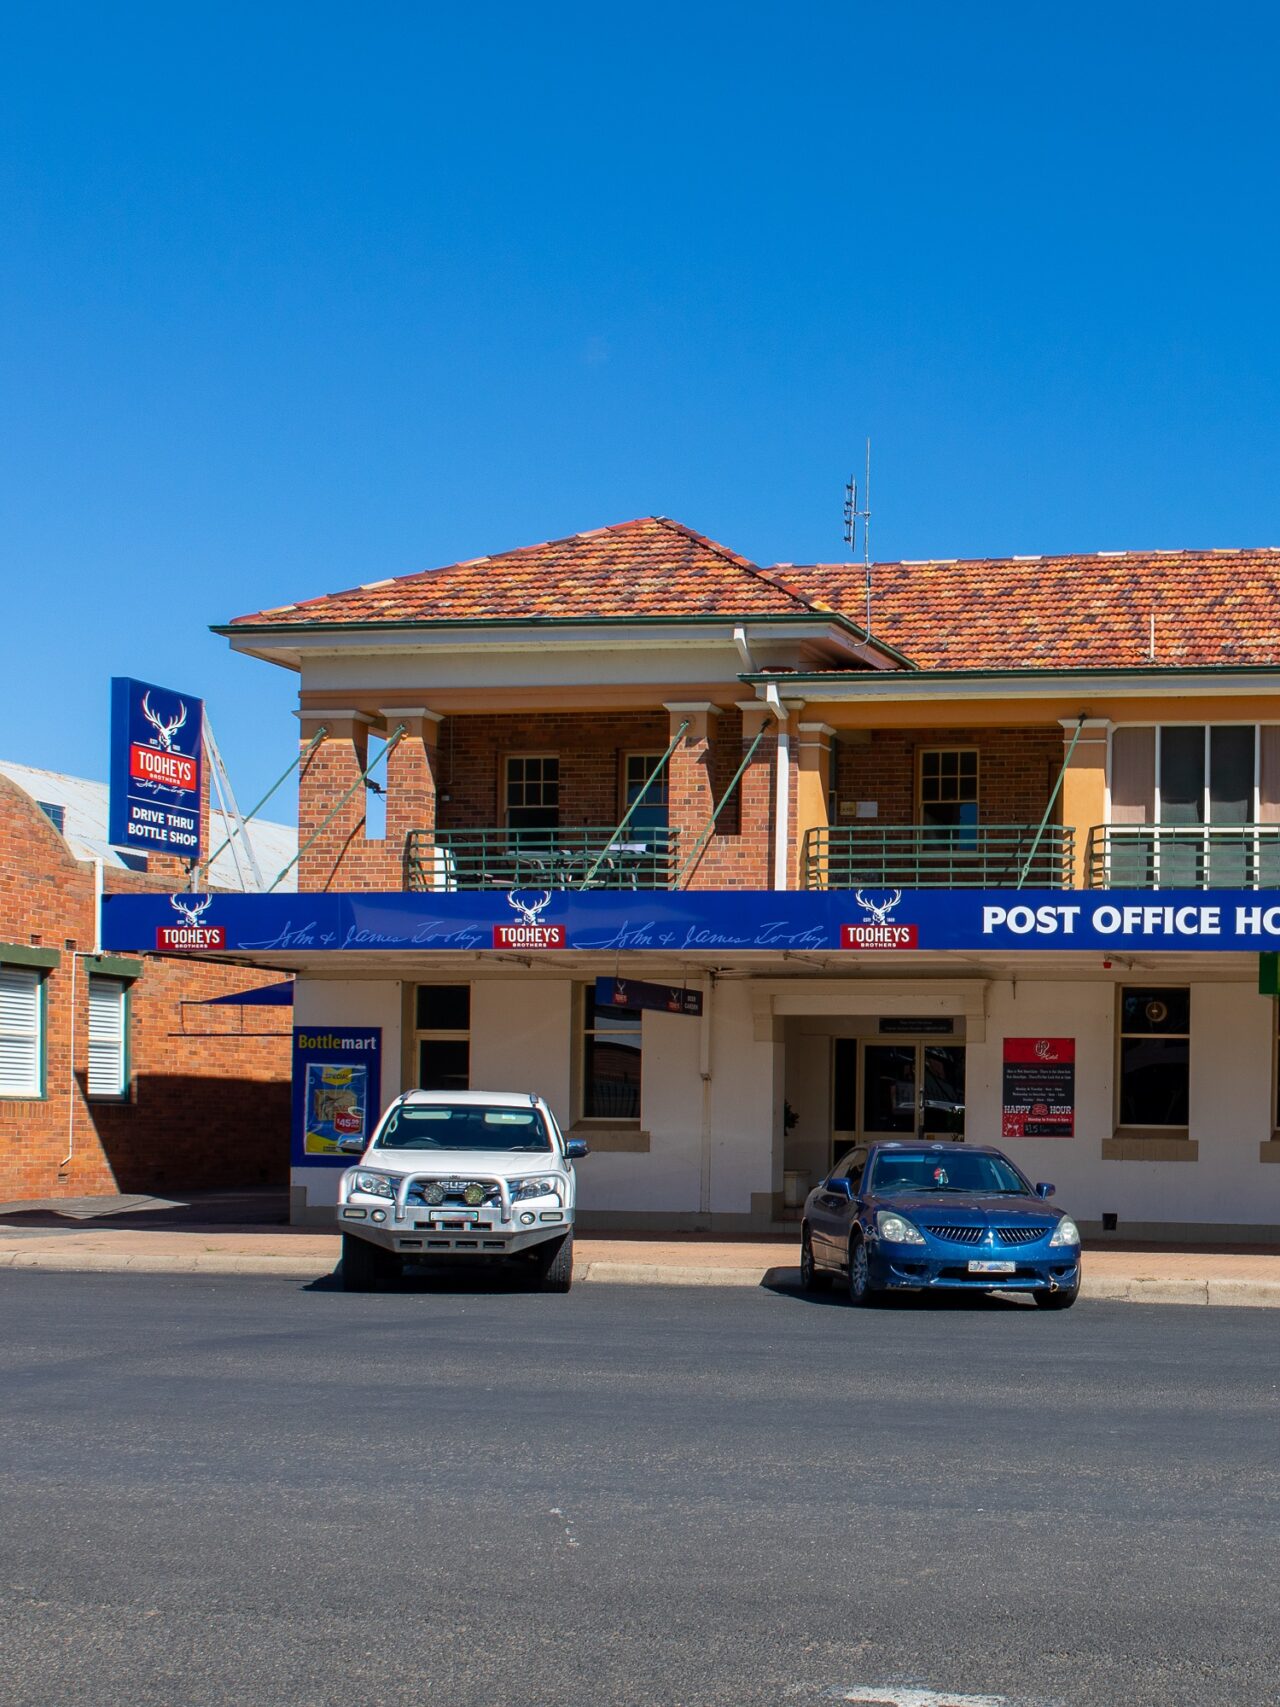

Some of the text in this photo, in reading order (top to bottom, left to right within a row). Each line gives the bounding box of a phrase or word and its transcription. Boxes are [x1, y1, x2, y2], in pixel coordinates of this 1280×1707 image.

[138, 751, 191, 781] TOOHEYS
[149, 773, 181, 785] BROTHERS
[132, 806, 195, 830] DRIVE THRU
[128, 823, 198, 846] BOTTLE SHOP
[983, 905, 1080, 934] POST
[1092, 905, 1221, 935] OFFICE
[163, 929, 220, 943] TOOHEYS
[500, 928, 560, 942] TOOHEYS
[847, 927, 910, 942] TOOHEYS
[298, 1034, 377, 1050] Bottlemart
[1003, 1105, 1072, 1115] HAPPY HOUR
